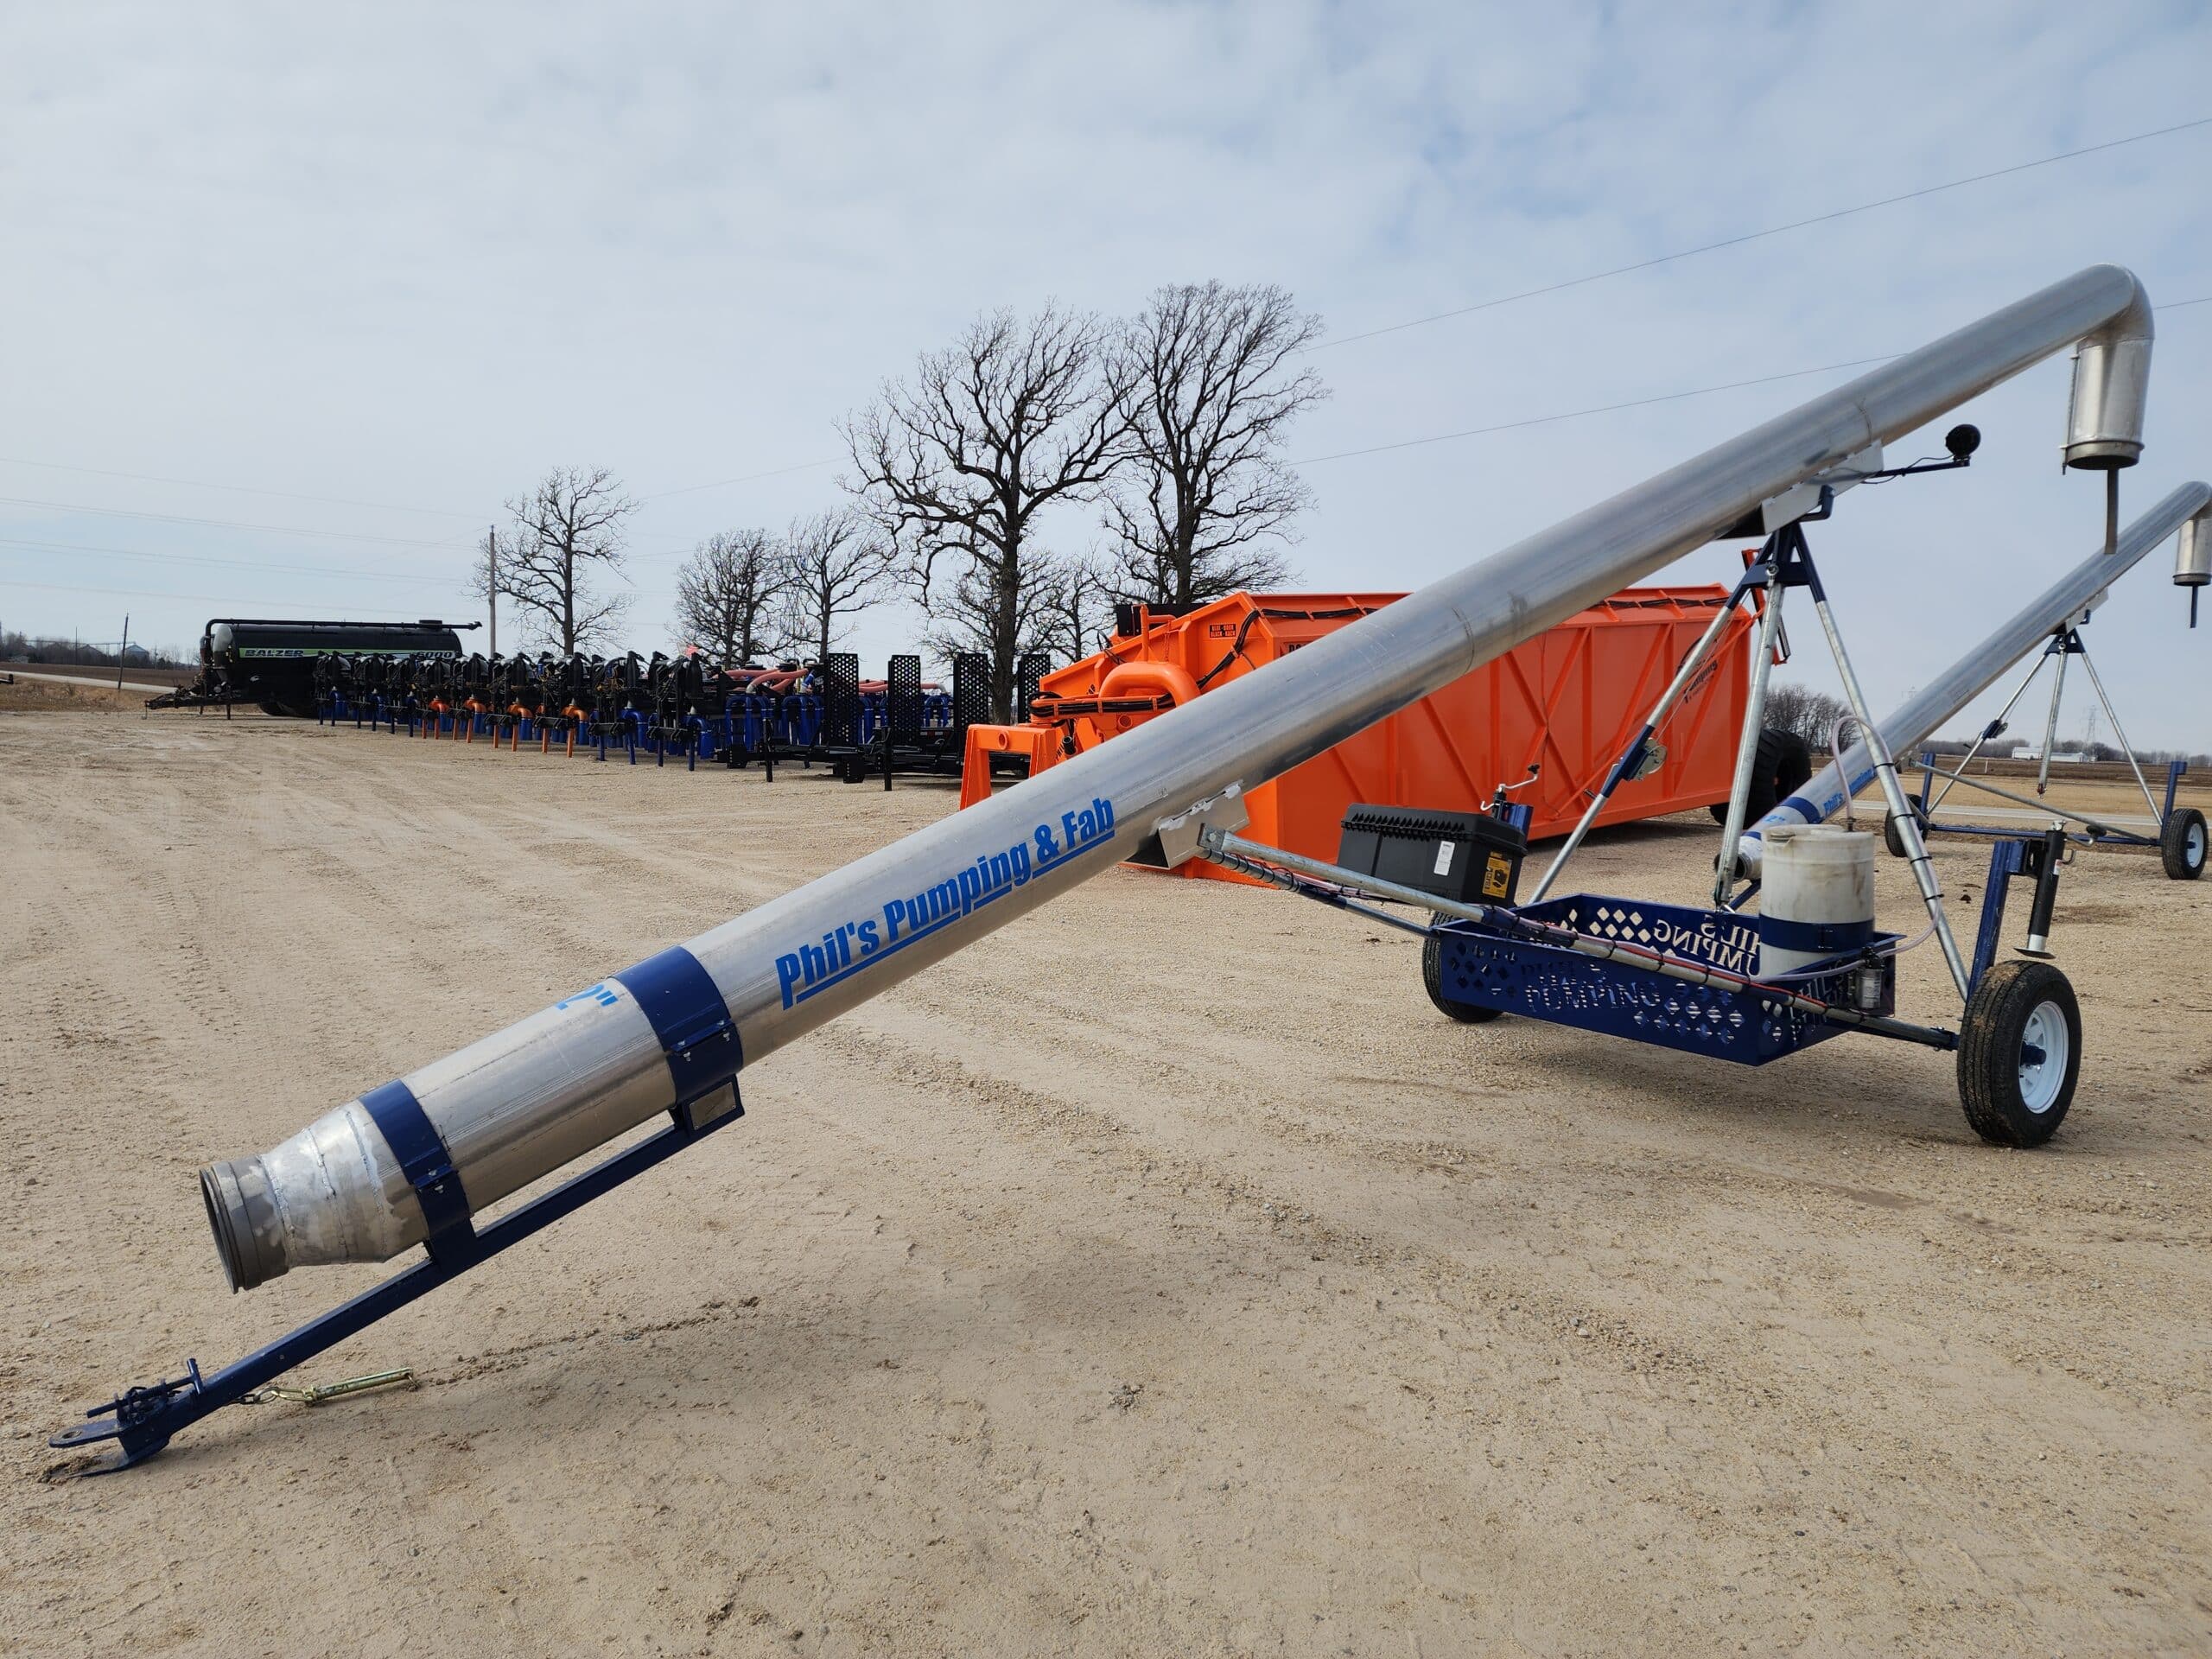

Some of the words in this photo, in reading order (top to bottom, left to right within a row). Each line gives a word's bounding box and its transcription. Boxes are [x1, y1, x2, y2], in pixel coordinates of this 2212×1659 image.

[775, 919, 880, 1010] Phil's
[883, 842, 1032, 943] Pumping
[1033, 823, 1059, 864] &
[1061, 798, 1115, 850] Fab
